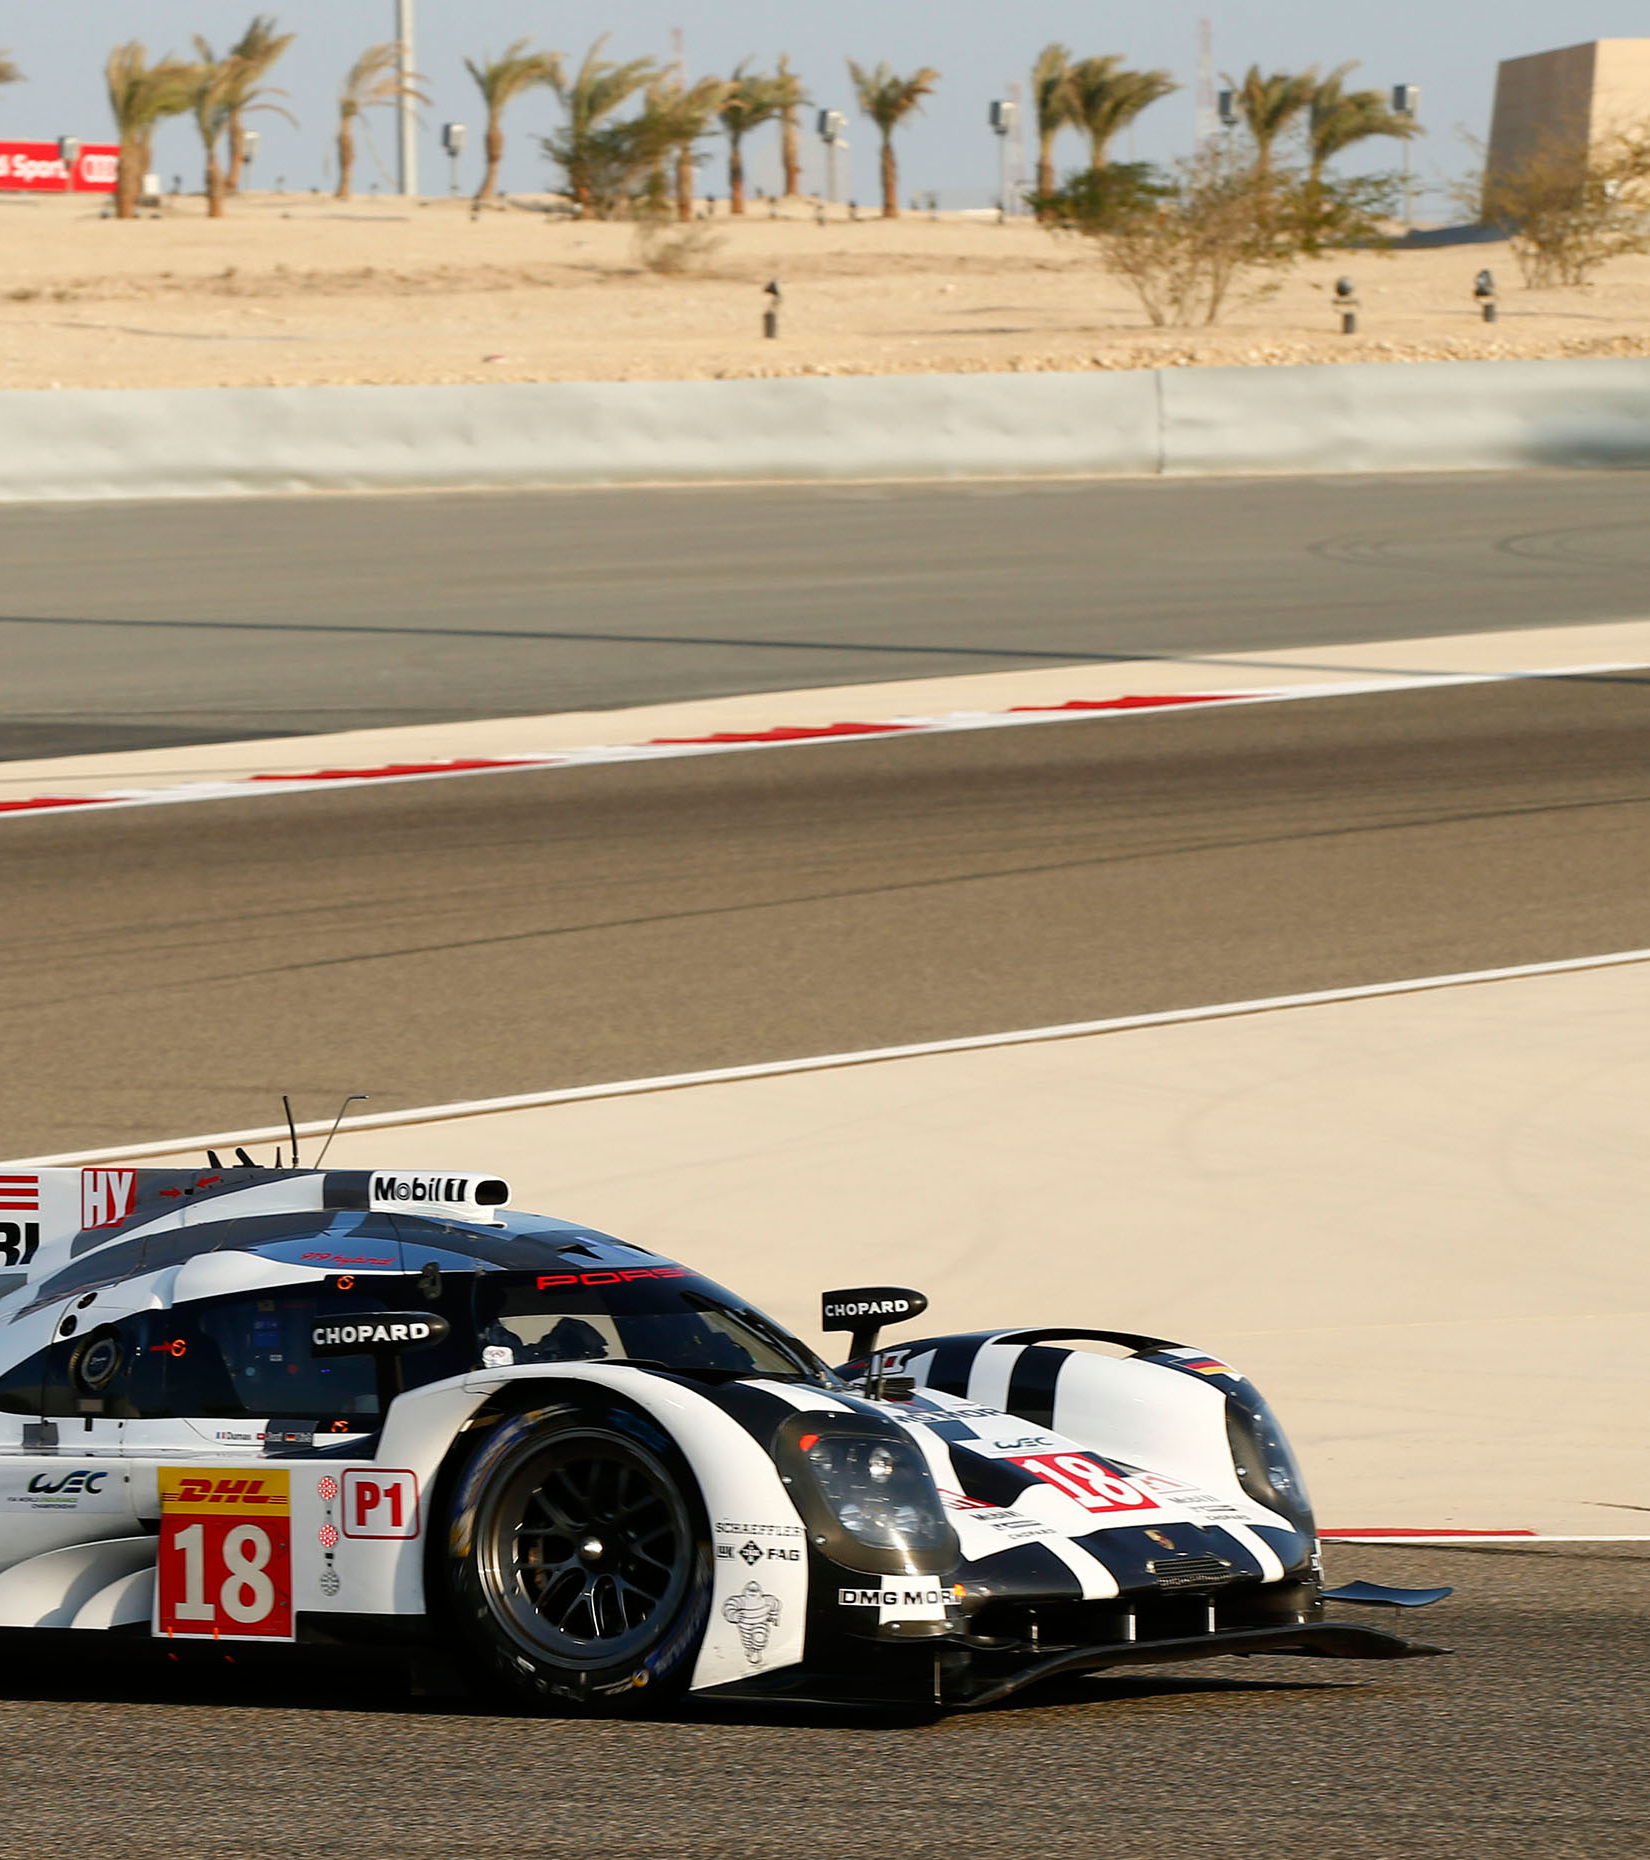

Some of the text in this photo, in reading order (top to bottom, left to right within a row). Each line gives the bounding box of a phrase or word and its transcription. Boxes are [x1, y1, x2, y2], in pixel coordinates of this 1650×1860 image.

[11, 153, 69, 182] Sport
[83, 1171, 134, 1229] HY
[824, 1299, 910, 1317] CHOPARD
[312, 1322, 431, 1346] CHOPARD
[27, 1470, 108, 1495] WEC
[177, 1478, 270, 1504] DHL
[1022, 1456, 1145, 1508] 18
[355, 1481, 404, 1527] P1
[715, 1522, 802, 1537] SCHAEFFLER
[767, 1547, 800, 1562] FAG
[174, 1523, 275, 1624] 18
[843, 1590, 898, 1605] DMG
